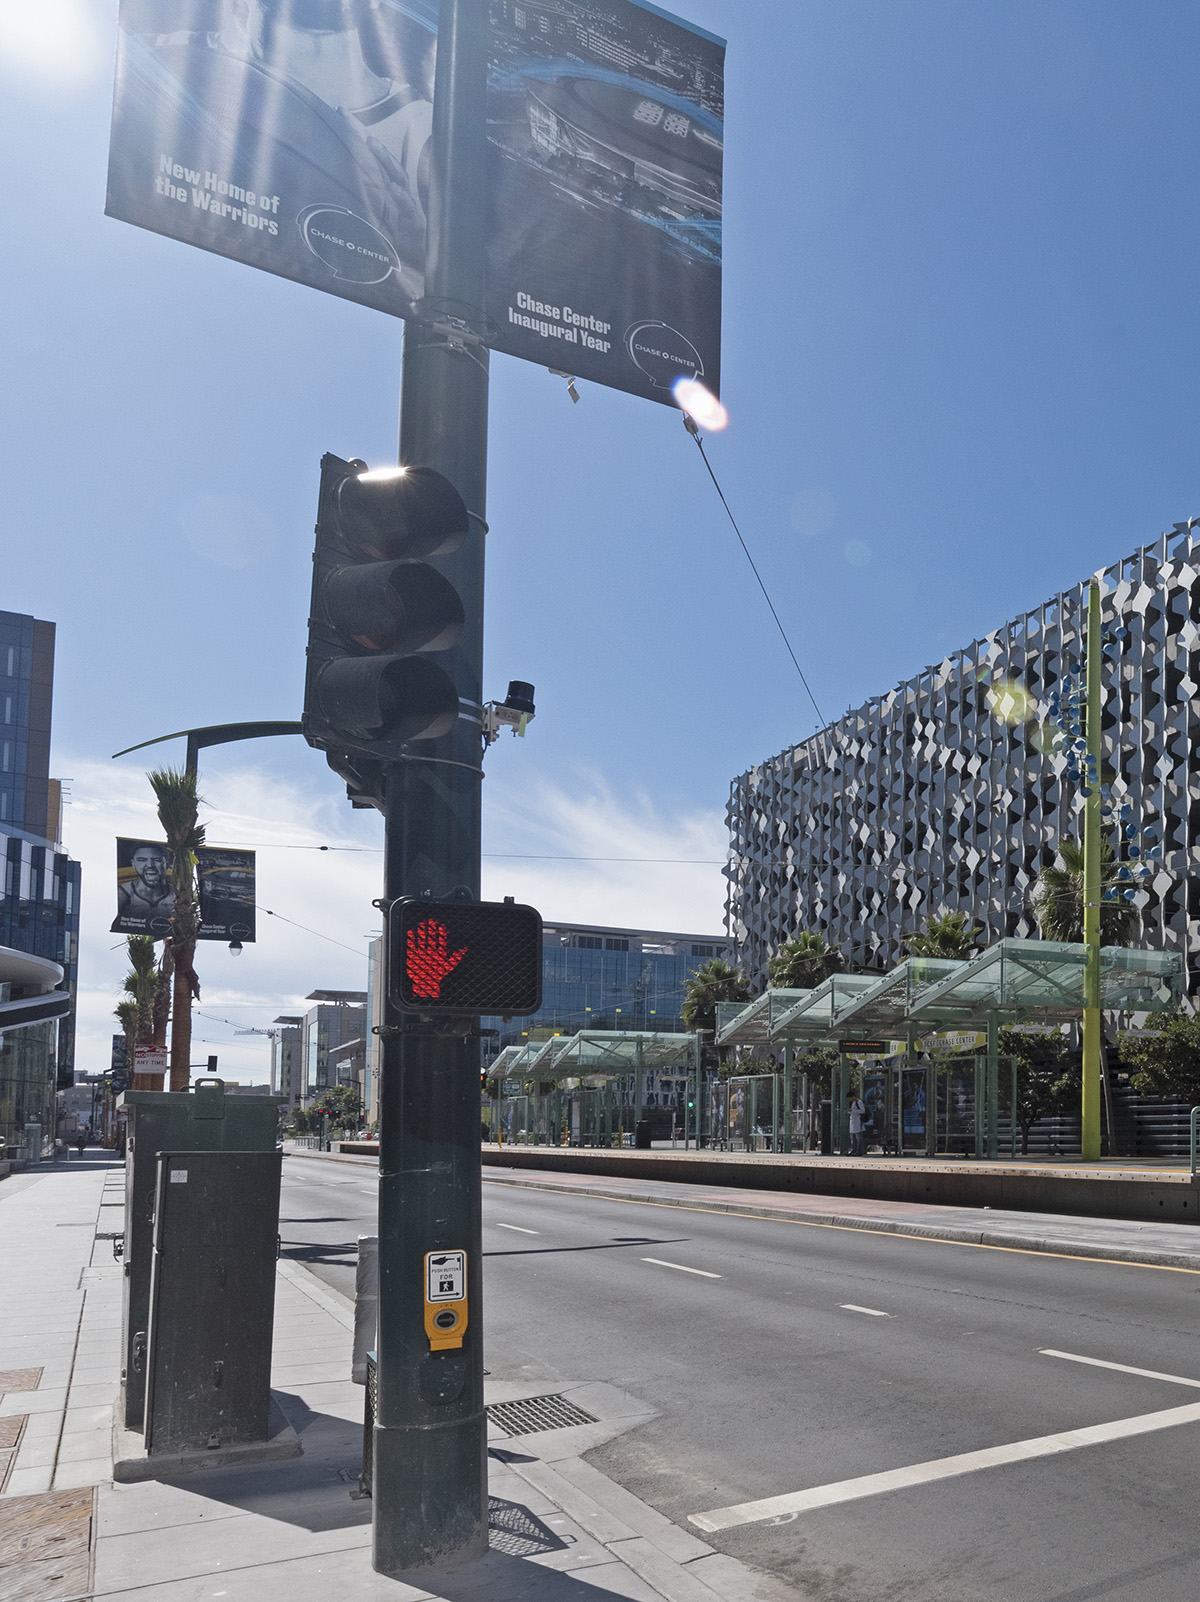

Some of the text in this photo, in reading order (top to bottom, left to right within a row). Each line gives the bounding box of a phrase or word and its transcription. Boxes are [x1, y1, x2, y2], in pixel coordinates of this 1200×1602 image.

[155, 176, 279, 236] the Warriors
[159, 154, 280, 214] New Home of
[310, 228, 390, 262] CHASE CENTER
[508, 307, 611, 353] Inaugural Year
[517, 291, 611, 335] Chase Center
[635, 343, 695, 368] CHASE CENTER
[955, 1035, 975, 1044] CENTER
